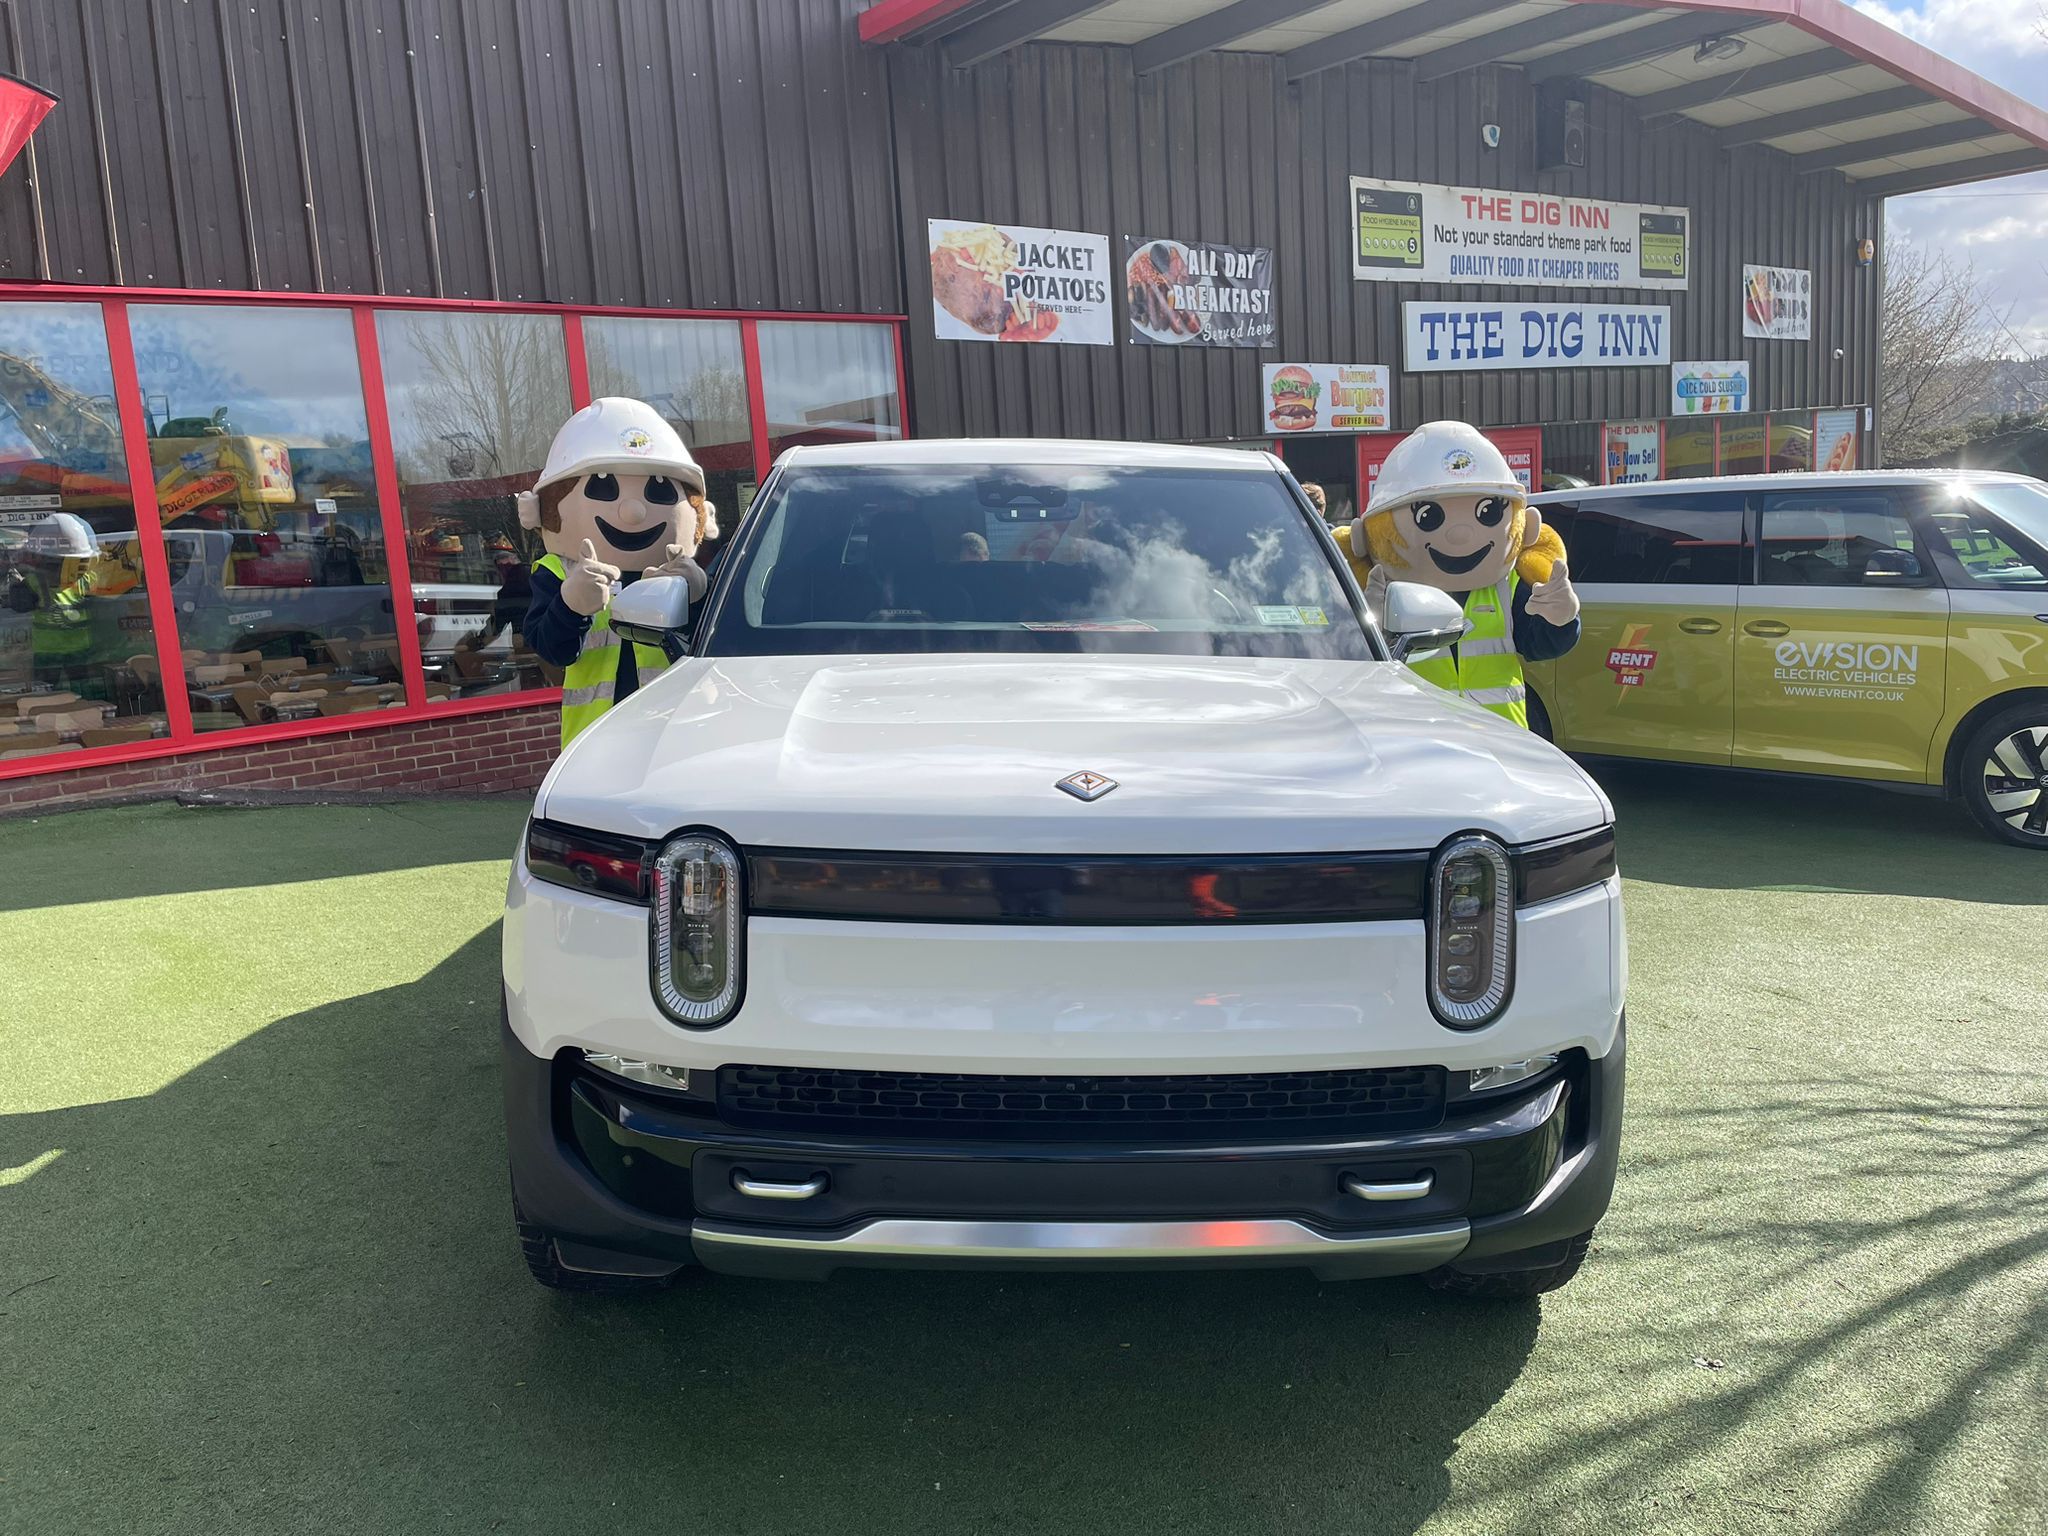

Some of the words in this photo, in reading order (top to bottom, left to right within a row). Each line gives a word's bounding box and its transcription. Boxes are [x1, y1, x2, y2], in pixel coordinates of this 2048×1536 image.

[1461, 195, 1512, 222] THE
[1521, 200, 1561, 225] DIG
[1569, 205, 1609, 230] INN
[1409, 239, 1416, 252] 5
[1434, 224, 1458, 243] Not
[1463, 230, 1489, 247] your
[1493, 230, 1544, 248] standard
[1548, 232, 1580, 250] theme
[1585, 236, 1607, 254] park
[1610, 238, 1632, 253] food
[1018, 243, 1094, 271] JACKET
[1188, 249, 1218, 277] ALL
[1224, 252, 1256, 279] DAY
[1450, 255, 1494, 276] QUALITY
[1498, 256, 1524, 277] FOOD
[1527, 258, 1540, 277] AT
[1542, 258, 1584, 279] CHEAPER
[1587, 261, 1619, 280] PRICES
[1005, 274, 1105, 304] POTATOES
[1173, 285, 1270, 314] BREAKFAST
[1037, 304, 1063, 313] SERVED
[1065, 305, 1082, 314] HERE
[1203, 320, 1244, 342] Served
[1247, 318, 1273, 337] here
[1420, 311, 1504, 361] THE
[1520, 311, 1584, 358] DIG
[1598, 313, 1662, 357] INN
[1339, 367, 1377, 383] Gourmet
[1686, 382, 1698, 394] ICE
[1700, 380, 1716, 393] COLD
[1330, 380, 1385, 413] Burgers
[1339, 416, 1361, 425] SERVED
[1606, 427, 1622, 435] THE
[1625, 425, 1639, 434] DIG
[1641, 424, 1656, 433] INN
[1369, 464, 1378, 476] NO
[1508, 453, 1530, 466] PICNICS
[1608, 450, 1620, 467] We
[1623, 448, 1641, 465] Now
[1642, 448, 1656, 464] Sell
[1519, 472, 1528, 481] Use
[8, 513, 26, 522] DIG
[1609, 652, 1653, 667] RENT
[1622, 675, 1639, 684] ME
[1774, 668, 1840, 682] ELECTRIC
[1844, 671, 1916, 685] VEHICLES
[1784, 686, 1904, 701] WWW.EVRENT.CO.UK
